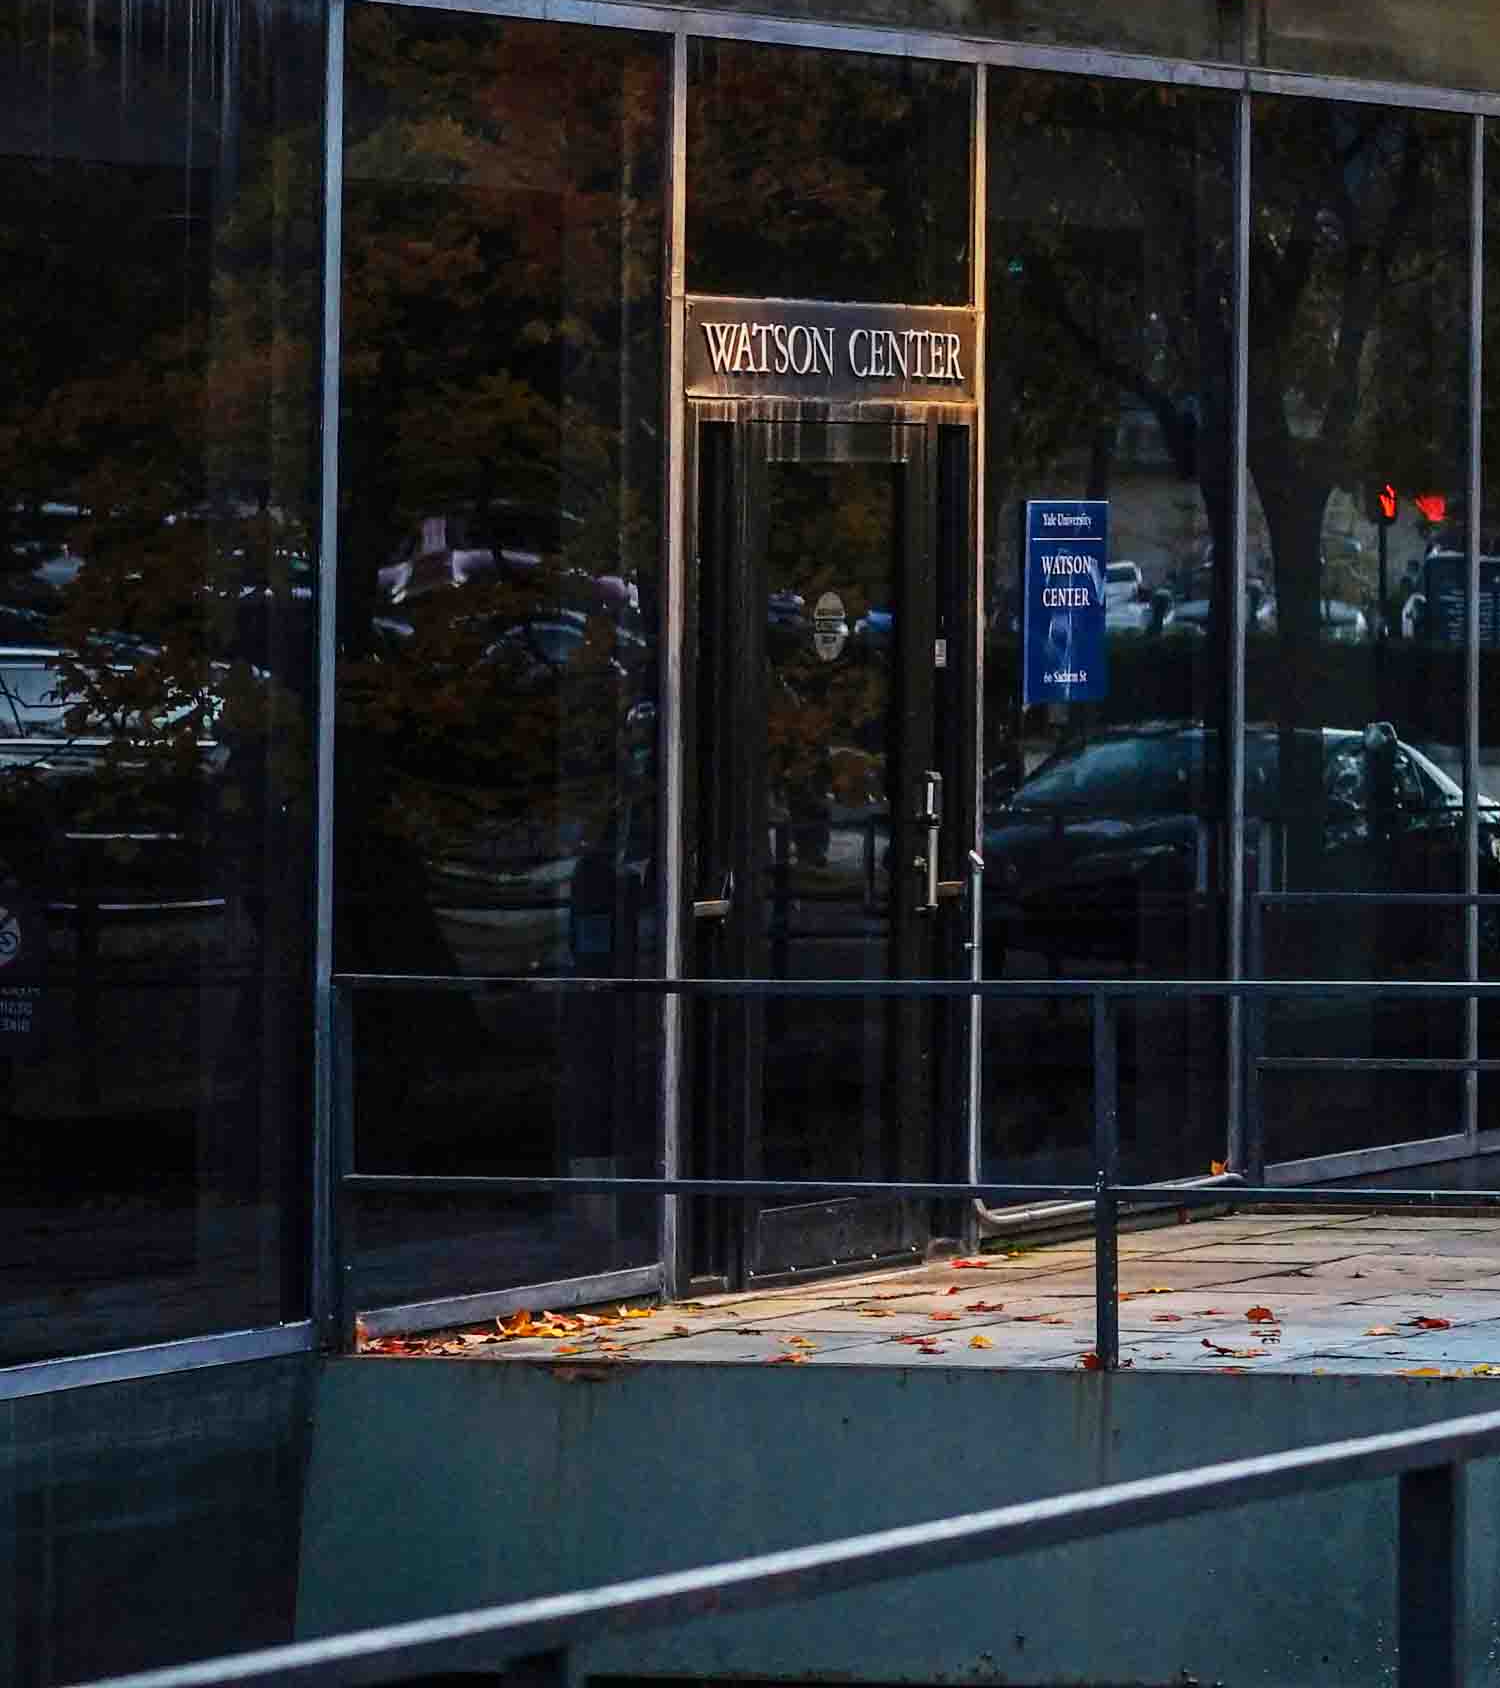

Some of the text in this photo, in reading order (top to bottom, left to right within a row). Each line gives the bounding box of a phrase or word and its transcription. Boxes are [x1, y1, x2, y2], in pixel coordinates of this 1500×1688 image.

[701, 322, 965, 380] WATSON CENTER
[1041, 555, 1090, 575] WATSON
[1042, 588, 1090, 607] CENTER
